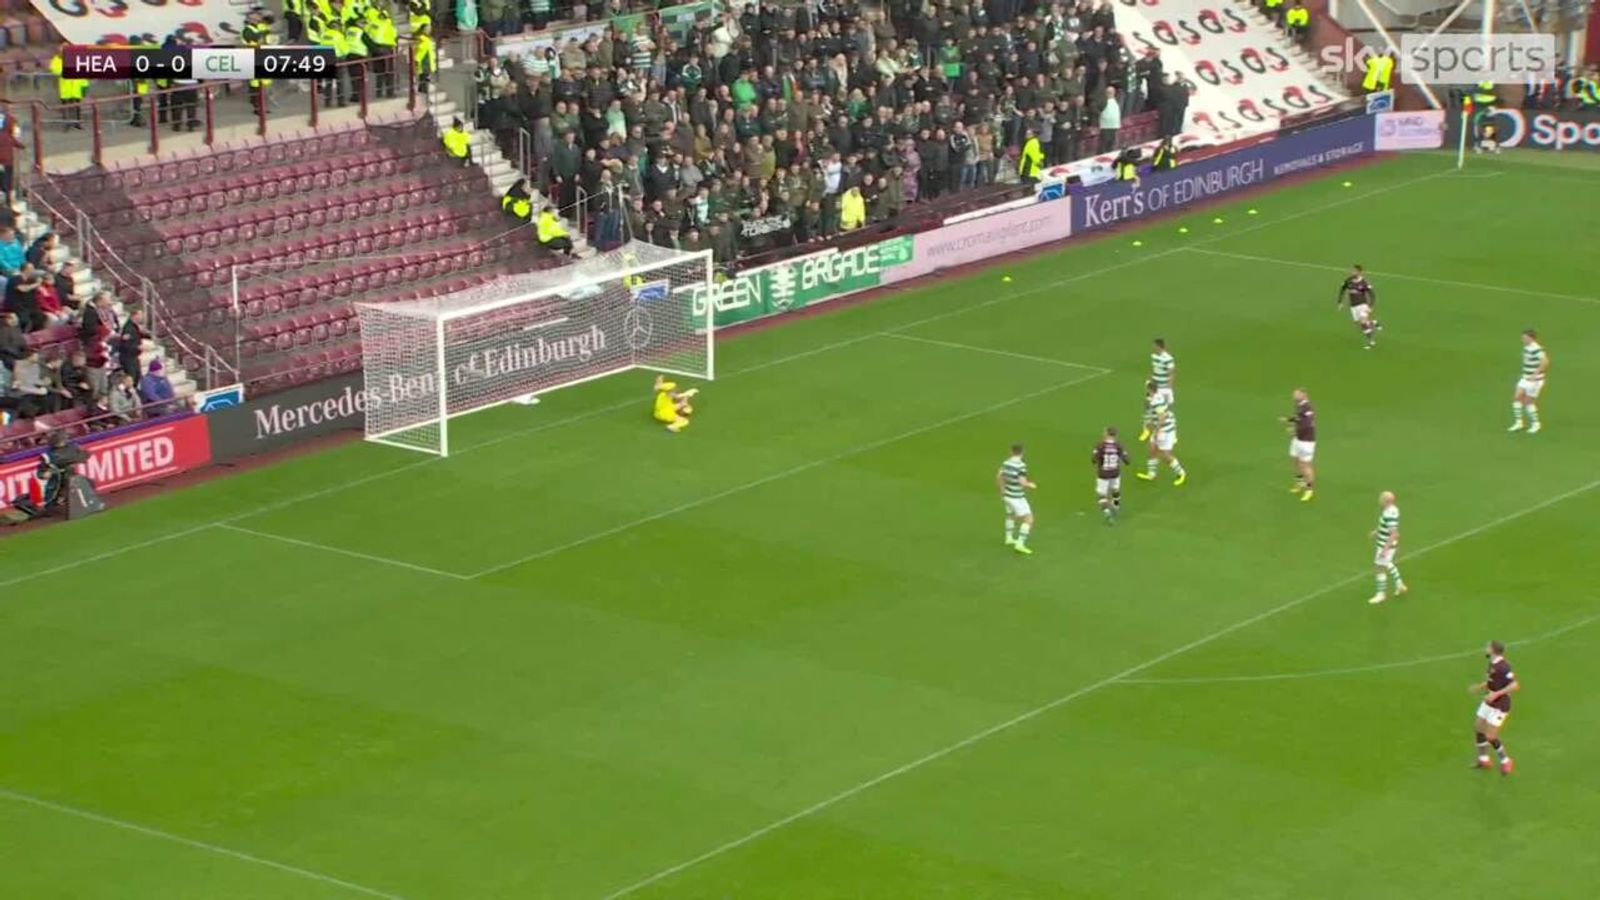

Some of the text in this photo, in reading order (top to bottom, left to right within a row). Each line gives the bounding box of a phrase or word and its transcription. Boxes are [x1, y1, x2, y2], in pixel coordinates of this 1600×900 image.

[1084, 157, 1265, 227] Kerr's OF EDINBURGH
[692, 274, 762, 317] GREEN
[802, 244, 880, 290] BRIGADE
[254, 368, 446, 441] Mercedes-Ben
[484, 325, 606, 379] Edinburgh
